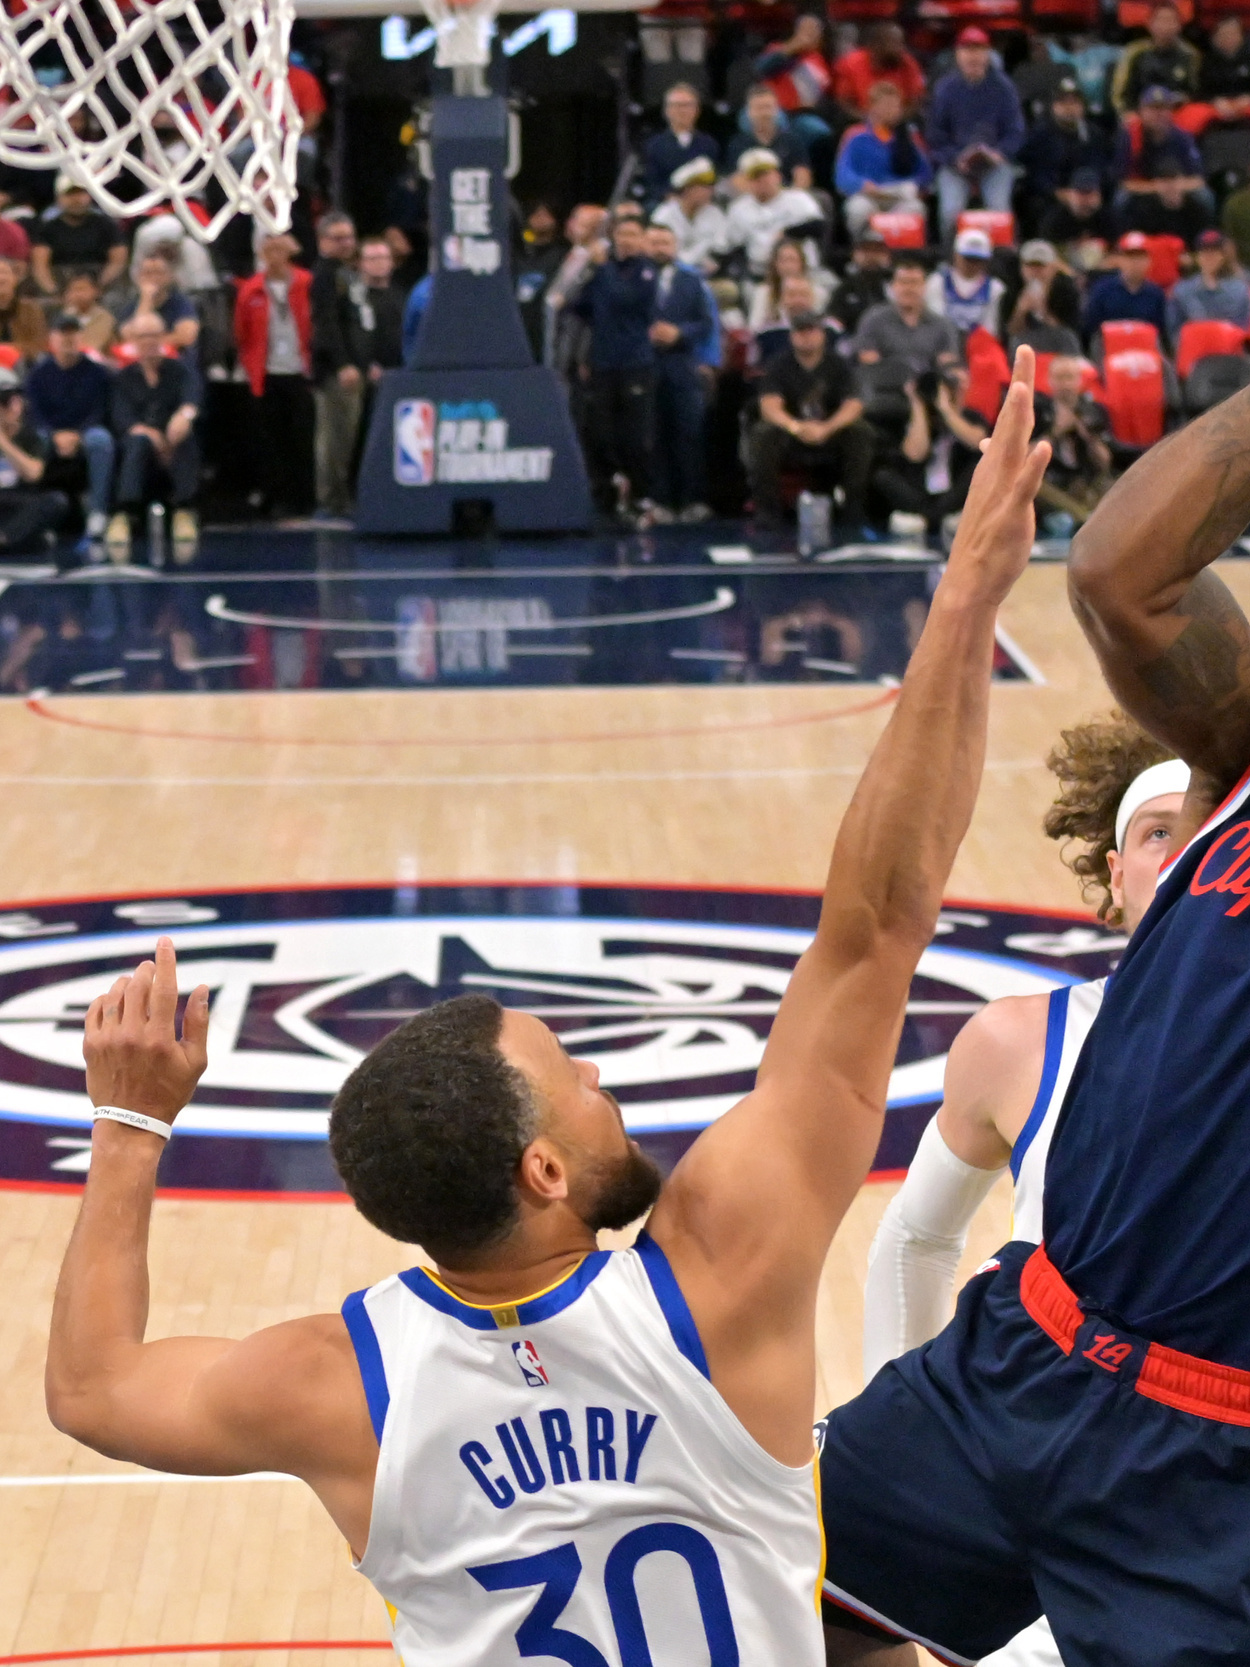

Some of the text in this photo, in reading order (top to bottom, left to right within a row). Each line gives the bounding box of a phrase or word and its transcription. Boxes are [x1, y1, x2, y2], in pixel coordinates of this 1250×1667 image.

[1082, 1334, 1133, 1373] LA
[459, 1406, 658, 1510] CURRY
[465, 1522, 740, 1667] 30
